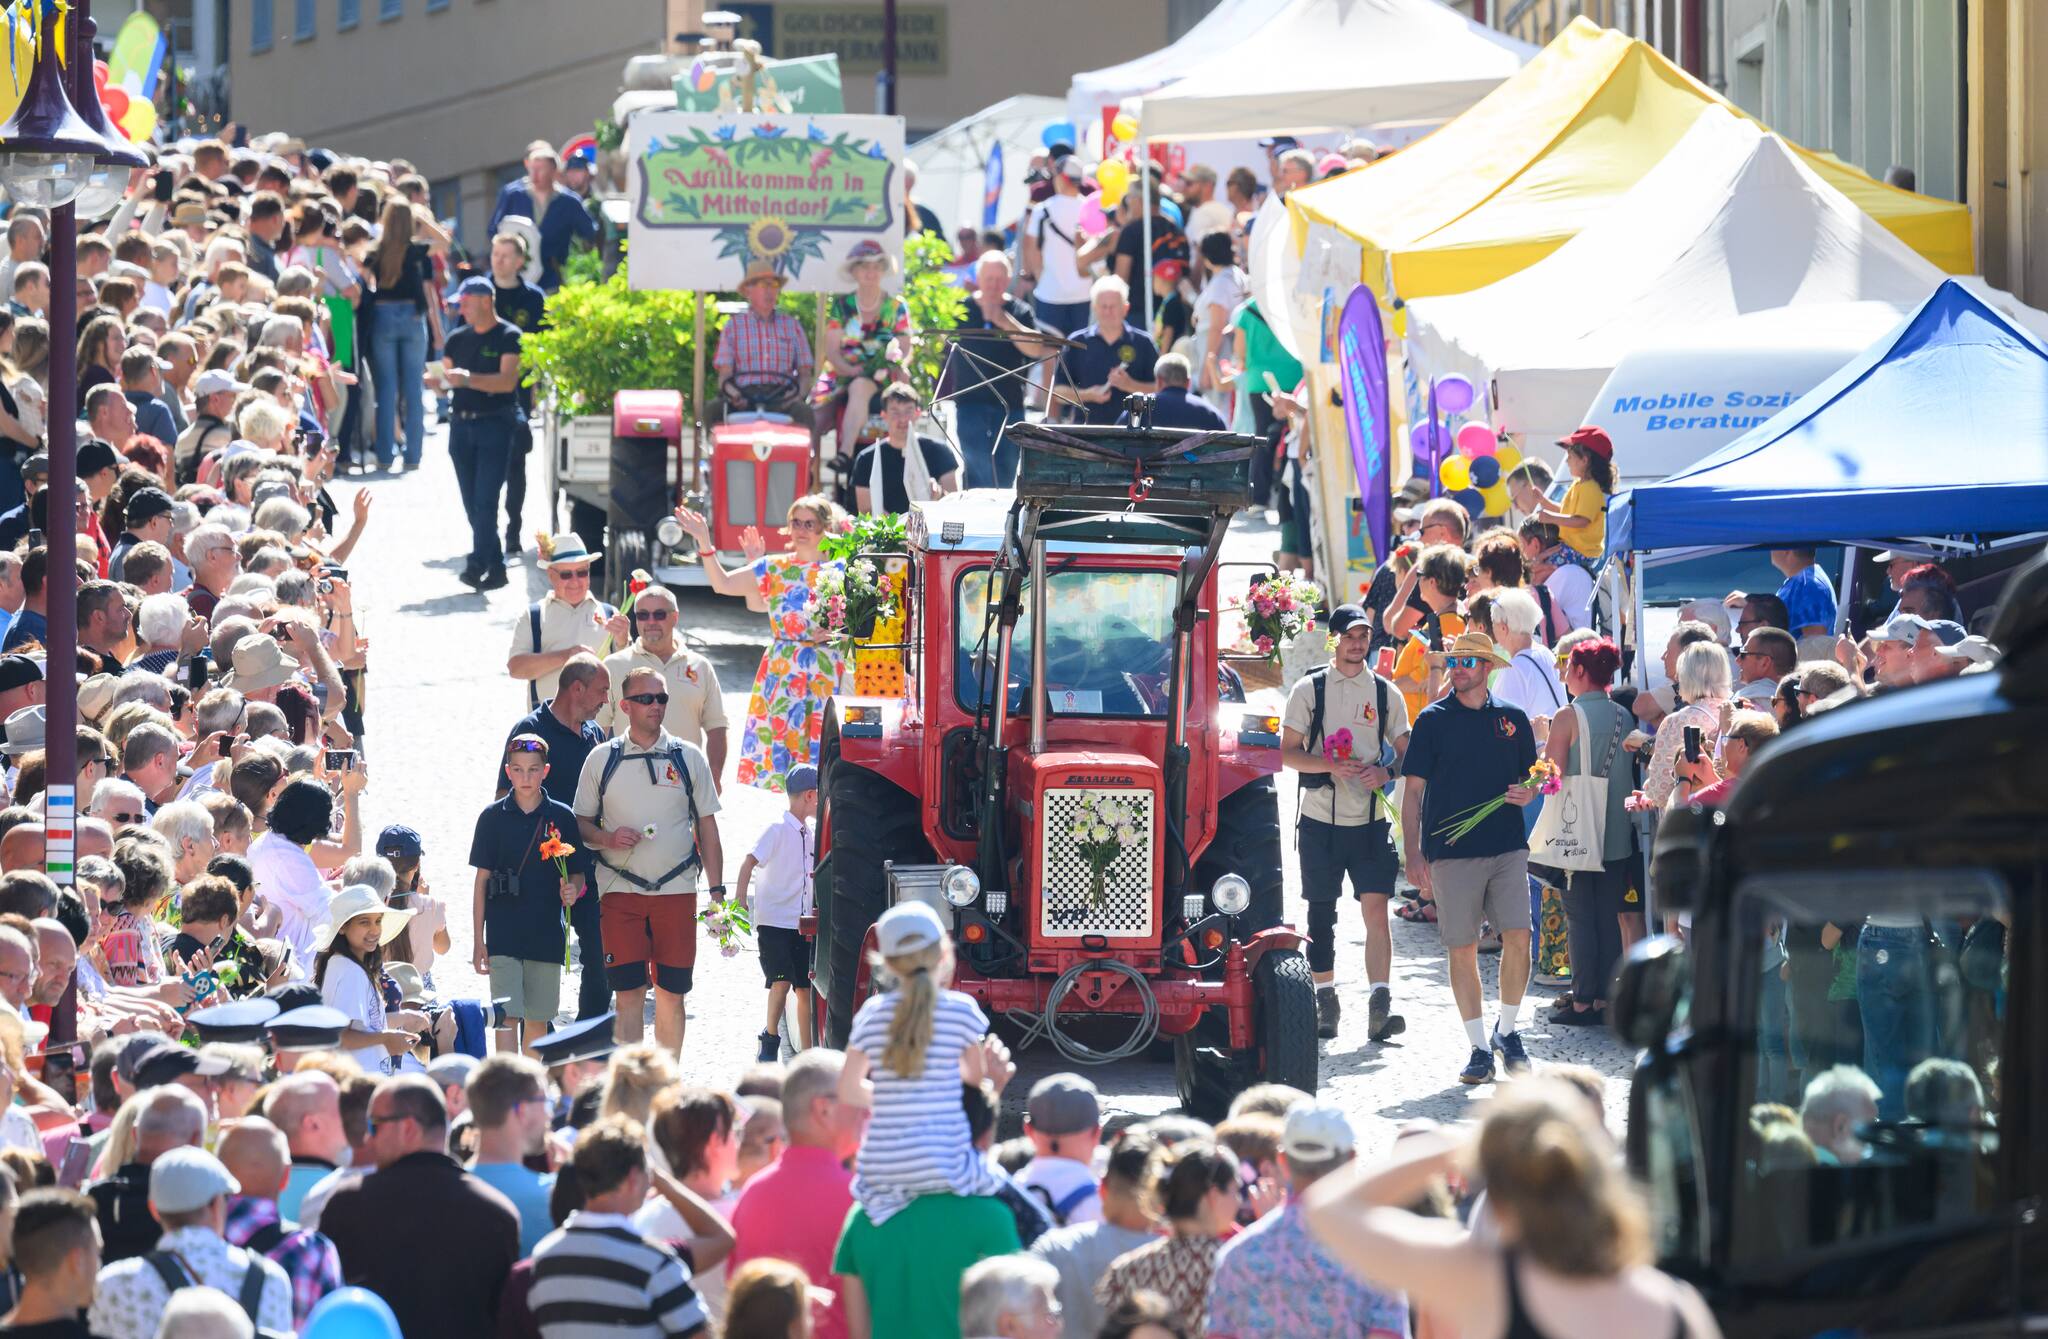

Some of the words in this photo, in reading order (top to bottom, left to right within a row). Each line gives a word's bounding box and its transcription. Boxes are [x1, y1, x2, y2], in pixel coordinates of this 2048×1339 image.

[784, 13, 935, 34] GOLDSCHMEDE
[663, 168, 833, 191] Willkommen
[845, 172, 865, 192] in
[702, 192, 830, 217] Mittelndorf
[1612, 391, 1715, 414] Mobile
